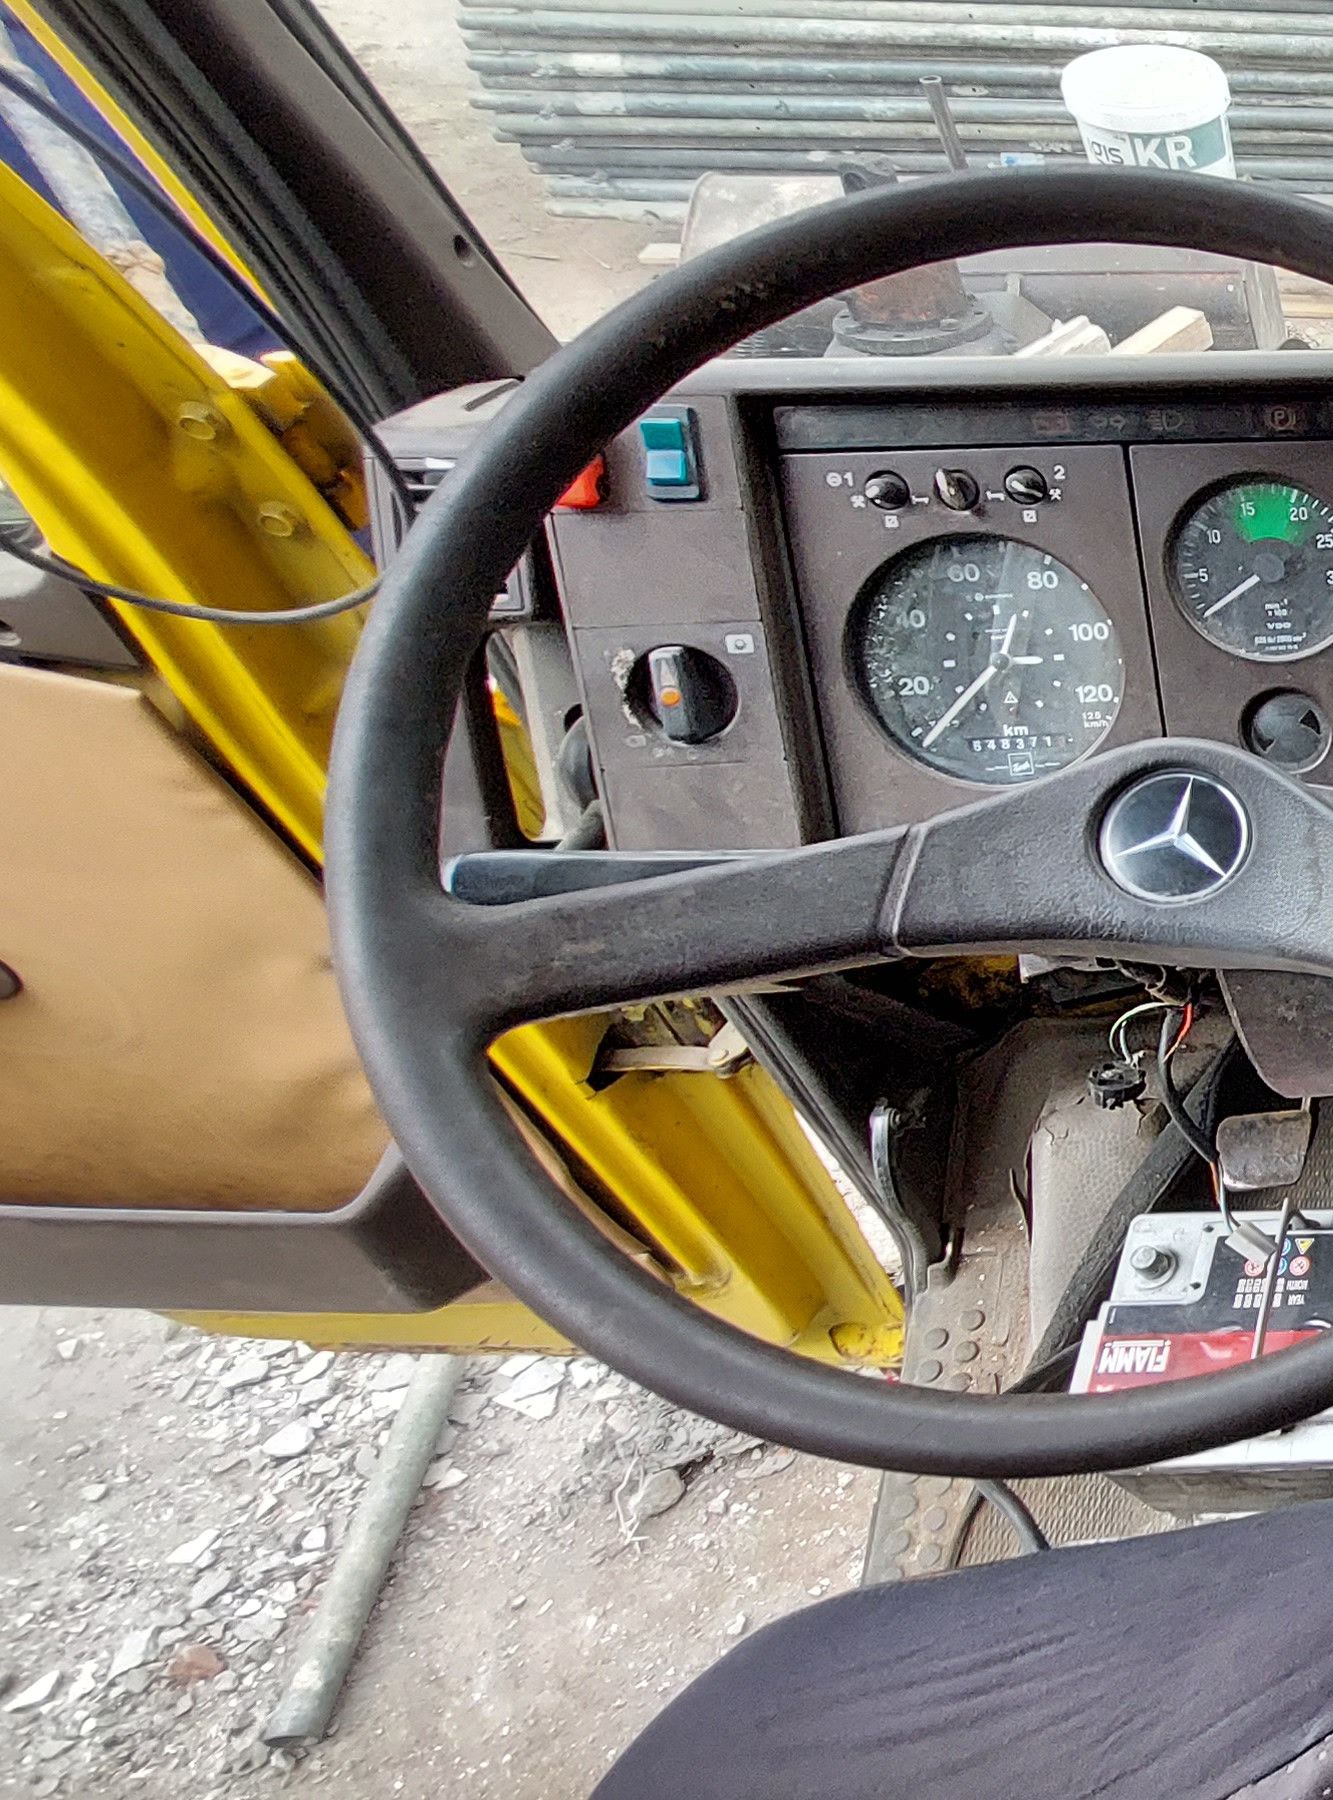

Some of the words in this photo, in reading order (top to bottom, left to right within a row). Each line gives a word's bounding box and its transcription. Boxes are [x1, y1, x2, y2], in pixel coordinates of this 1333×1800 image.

[1053, 464, 1066, 481] 2
[1241, 502, 1256, 517] 15
[1290, 506, 1308, 522] 20
[1207, 529, 1222, 544] 10
[1316, 533, 1333, 549] 25
[947, 563, 981, 582] 60
[1027, 571, 1059, 590] 80
[1198, 568, 1209, 582] 5
[1068, 621, 1110, 642] 100
[1265, 621, 1292, 630] VDO
[898, 676, 930, 696] 20
[1075, 684, 1114, 703] 120
[1003, 724, 1029, 736] km
[1097, 1342, 1170, 1374] FIAMM
